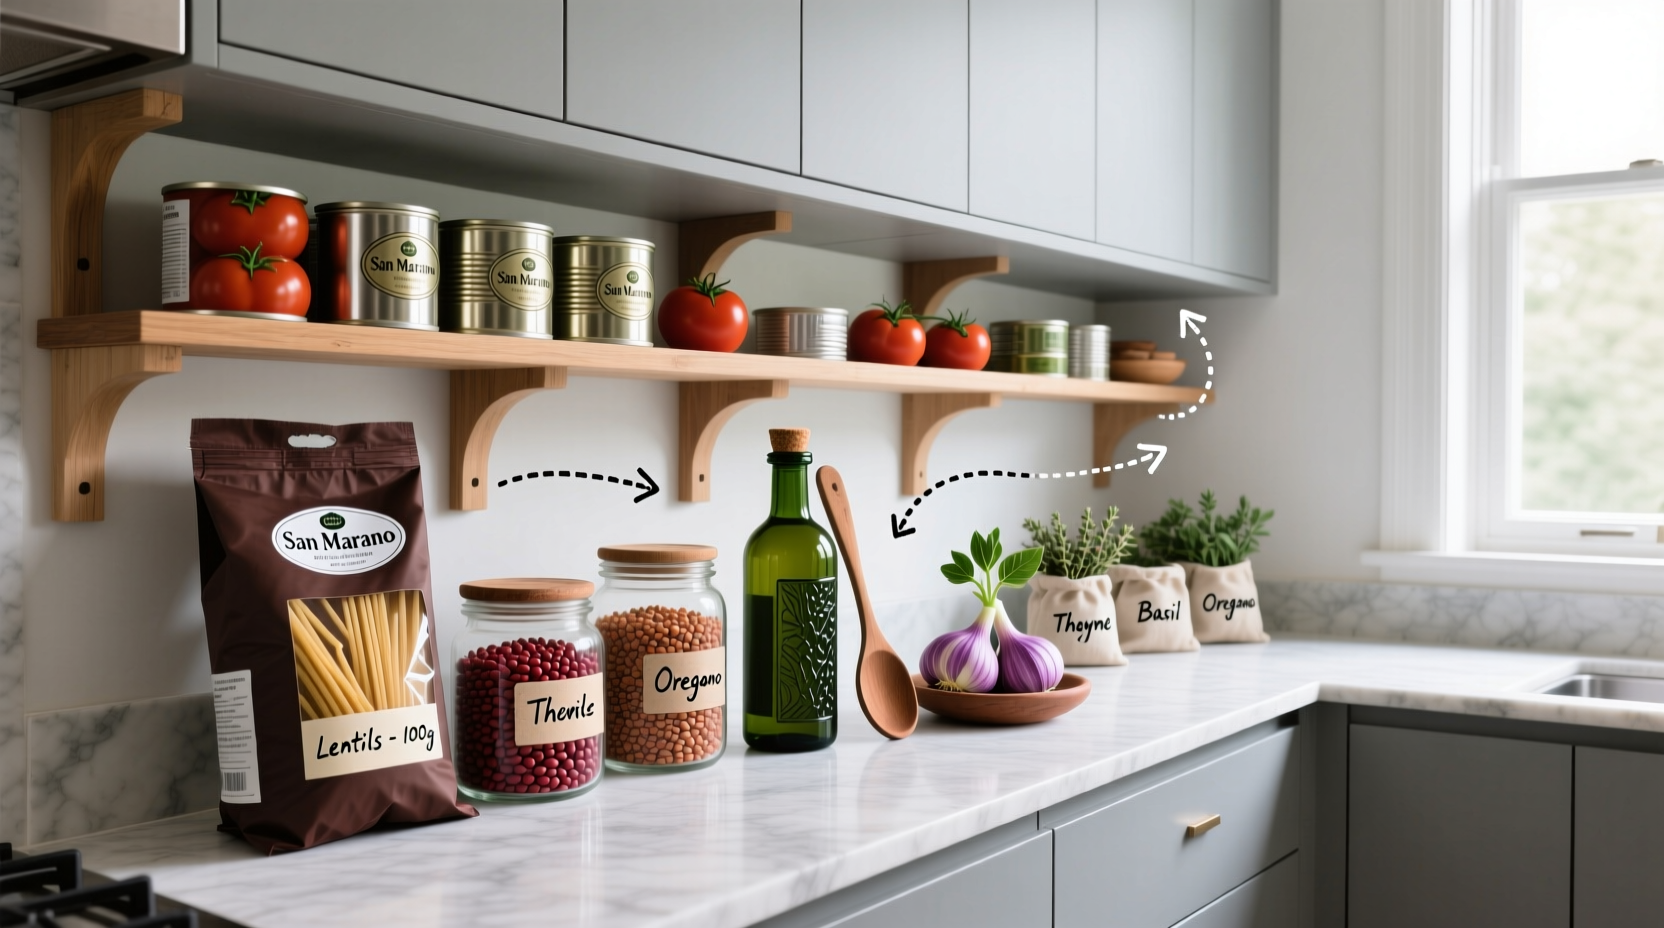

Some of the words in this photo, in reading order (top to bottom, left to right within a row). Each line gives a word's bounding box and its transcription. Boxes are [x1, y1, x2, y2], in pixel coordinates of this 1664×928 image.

[370, 256, 393, 272] San
[497, 271, 517, 284] San
[282, 531, 319, 550] San
[321, 530, 396, 550] Marano
[1137, 600, 1181, 623] Basil
[1202, 592, 1256, 622] Oregano
[654, 665, 722, 702] Oregano
[316, 727, 382, 760] Lentils
[403, 724, 435, 752] 100g
